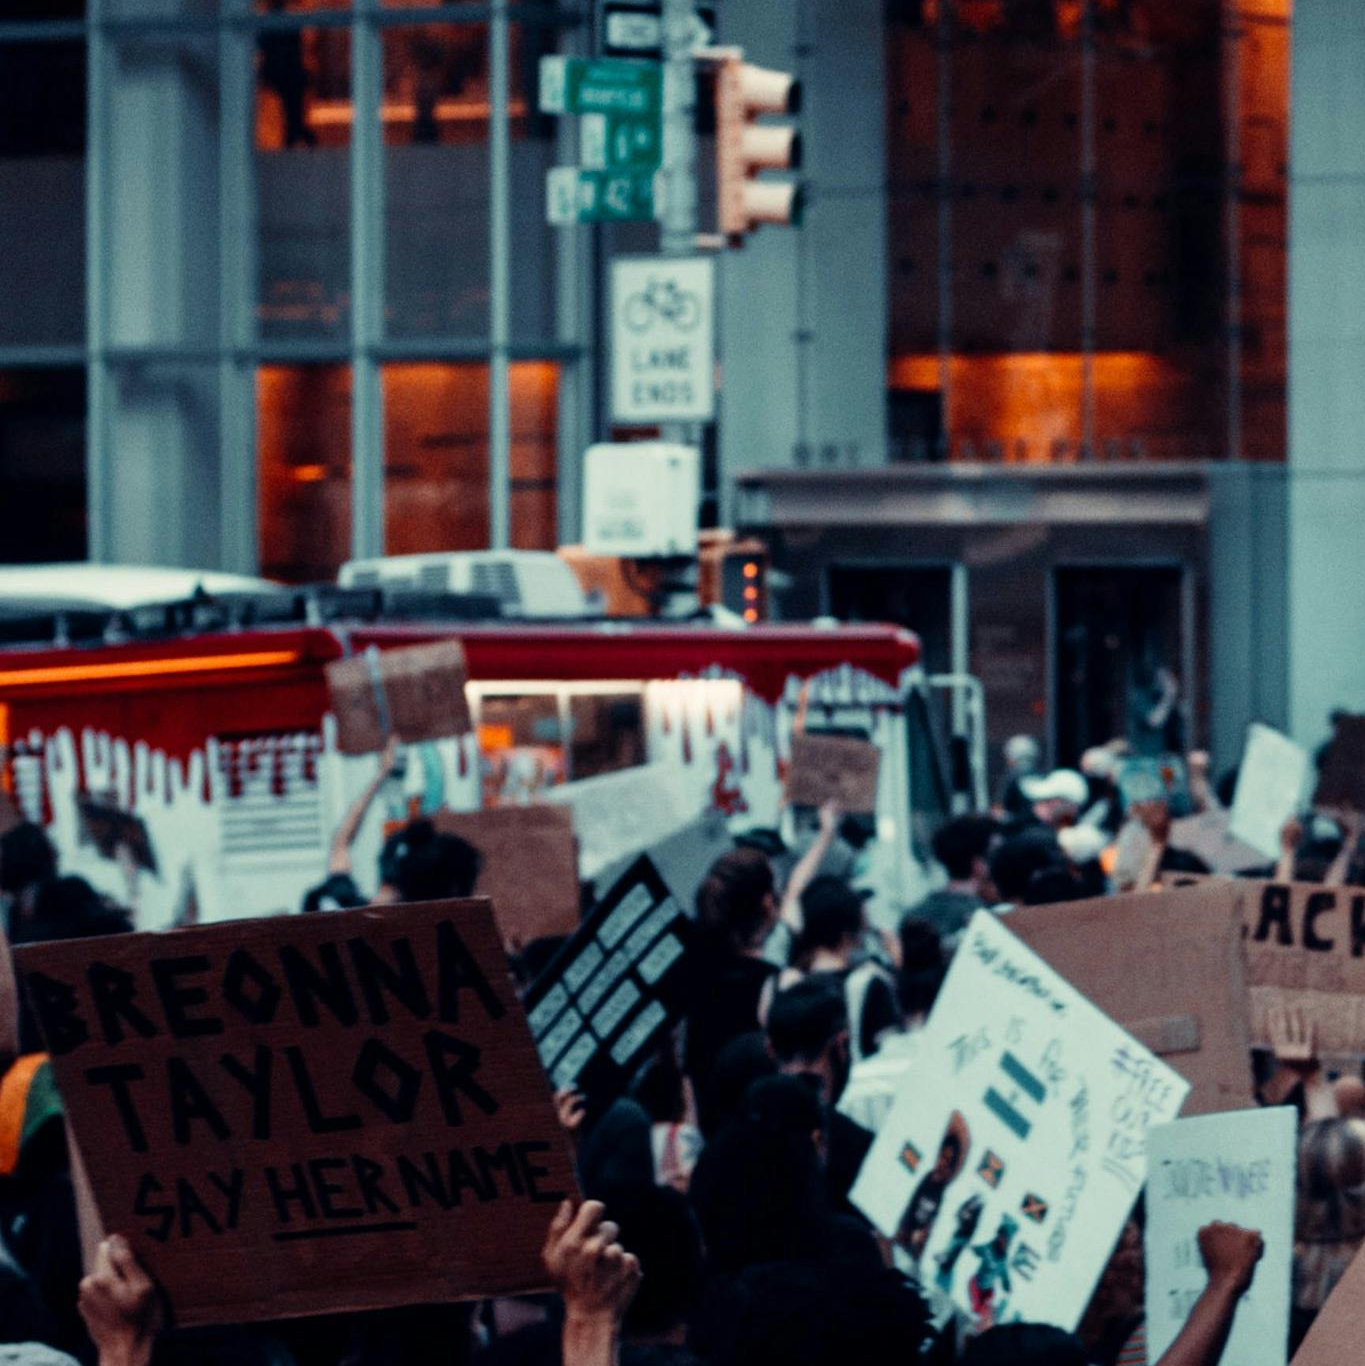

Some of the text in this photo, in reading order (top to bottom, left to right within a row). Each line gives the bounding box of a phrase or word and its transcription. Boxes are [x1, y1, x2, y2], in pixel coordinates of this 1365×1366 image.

[629, 346, 691, 372] LANE
[631, 379, 694, 405] ENDS
[26, 919, 507, 1055] BREONNA
[86, 1033, 499, 1153] TAYLOR
[134, 1141, 567, 1243] SAY HER NAME
